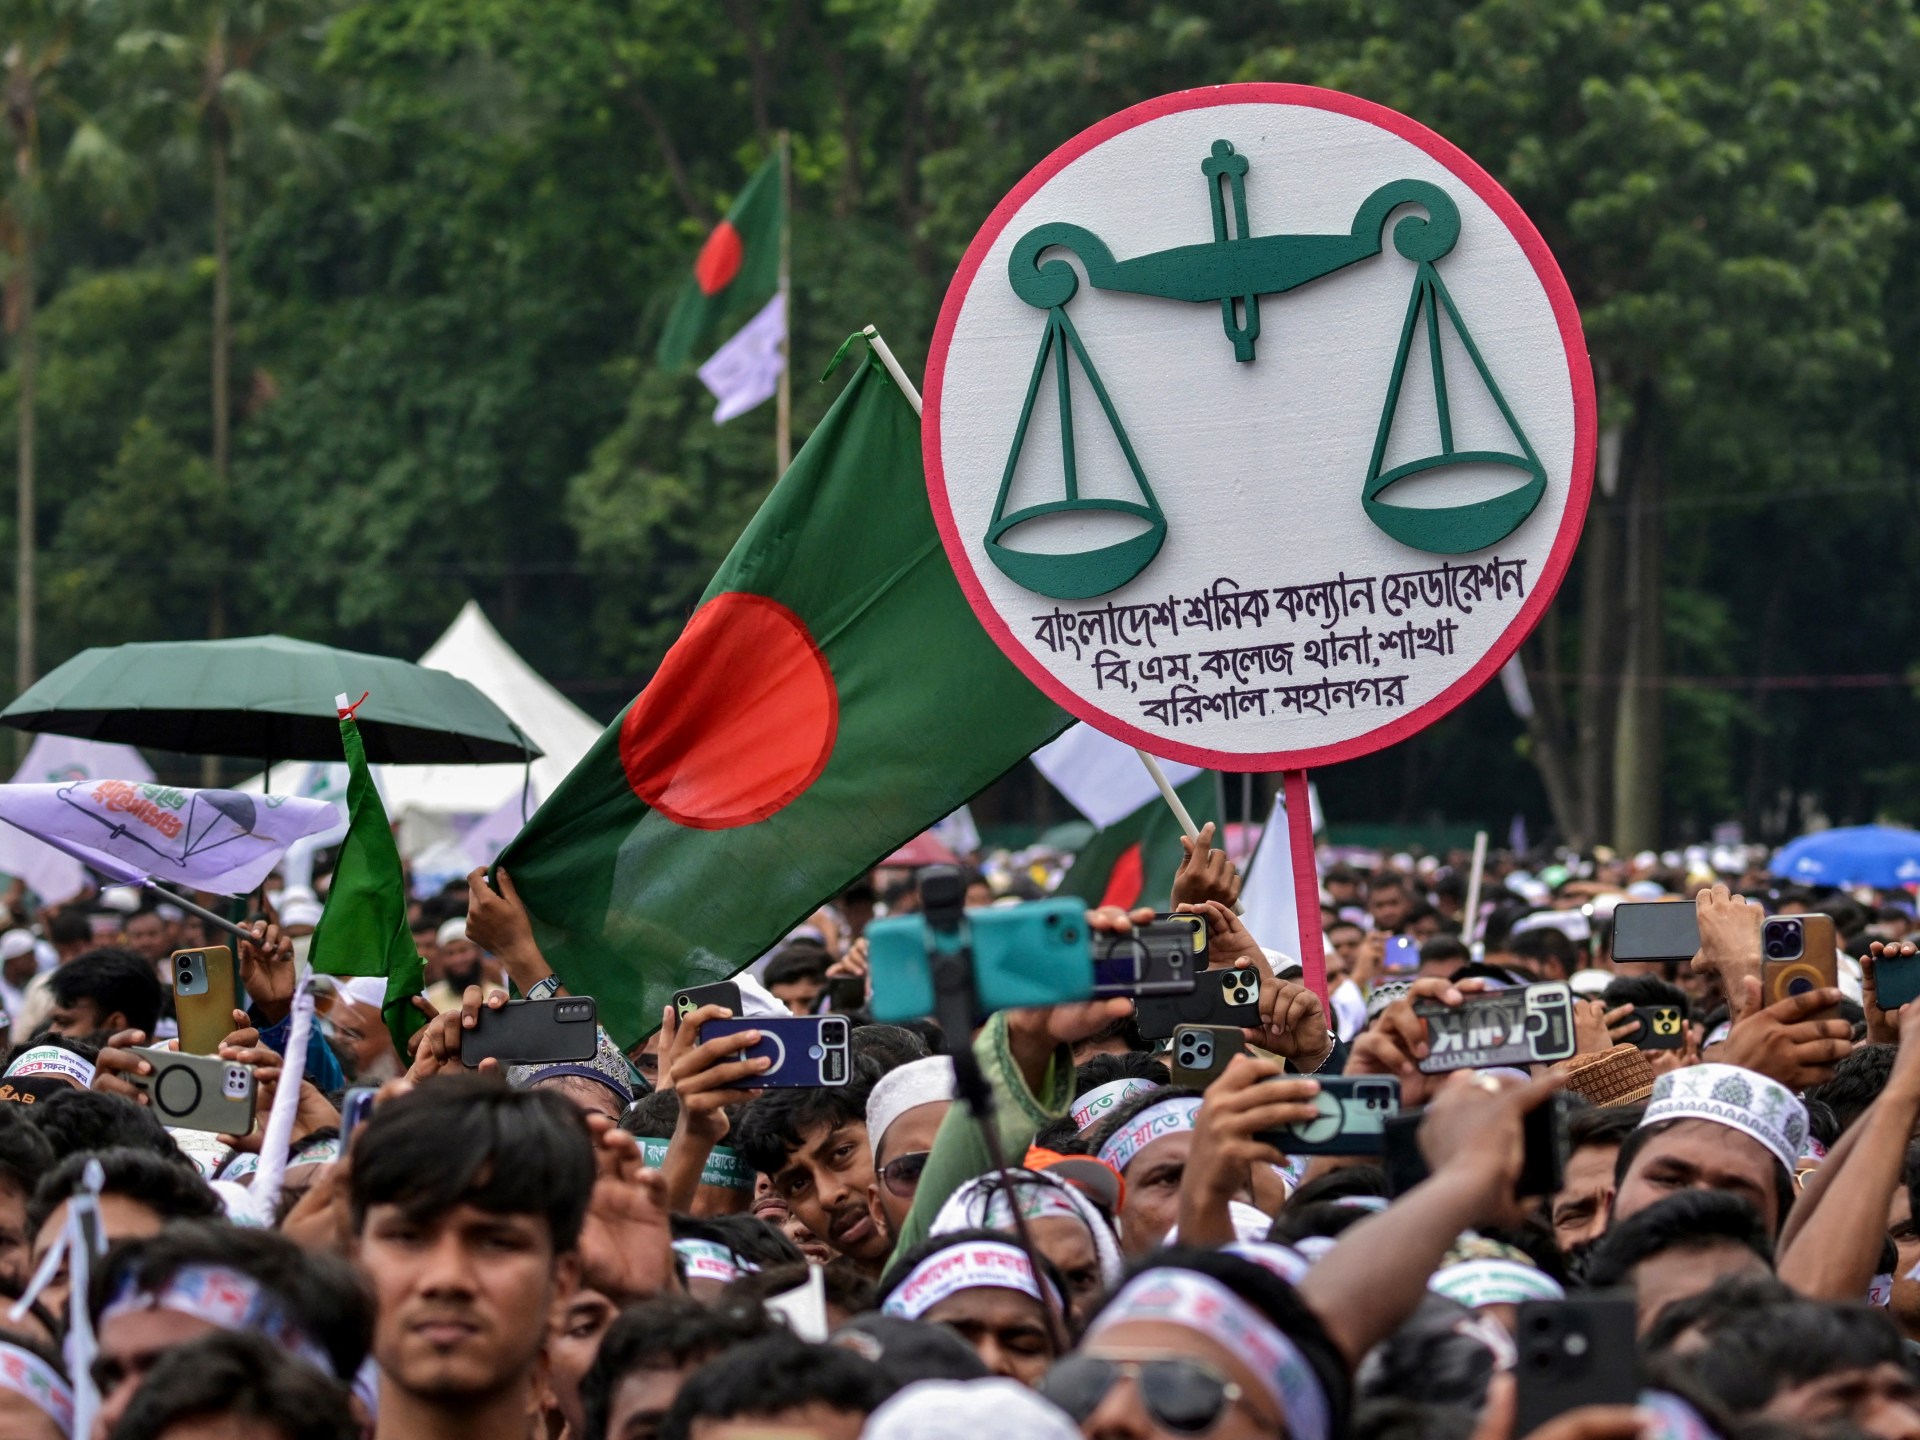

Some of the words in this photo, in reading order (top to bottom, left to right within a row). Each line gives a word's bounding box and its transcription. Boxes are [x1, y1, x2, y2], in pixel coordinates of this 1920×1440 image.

[1032, 595, 1181, 660] বাংলাদেশ
[1183, 577, 1269, 631] শ্রমিক
[1273, 571, 1376, 629] কল্যান
[1381, 556, 1527, 614] ফেডারেশন
[1274, 675, 1409, 716] মহানগর
[43, 1062, 66, 1072] সফল
